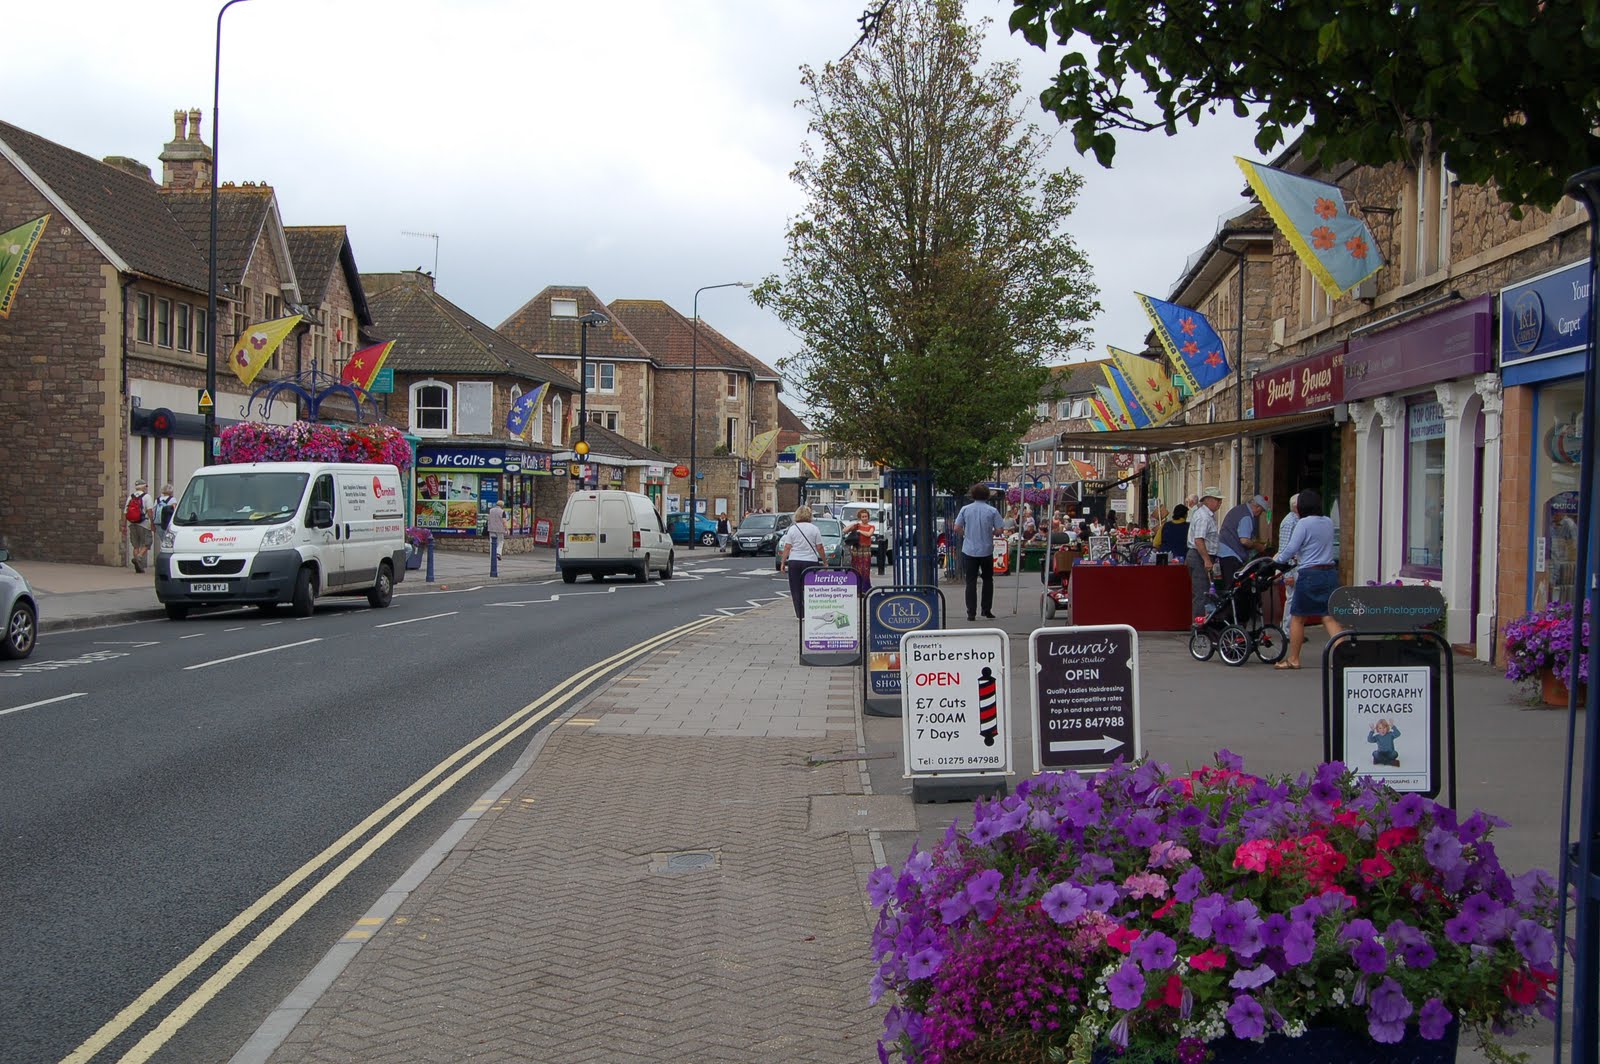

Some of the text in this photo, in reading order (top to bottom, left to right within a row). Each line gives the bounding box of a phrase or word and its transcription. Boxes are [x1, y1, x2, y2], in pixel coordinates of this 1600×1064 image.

[1572, 280, 1590, 301] Your
[1558, 317, 1581, 337] Carpet
[1266, 366, 1332, 408] Juicy Jones
[1412, 406, 1424, 425] TOP
[814, 574, 848, 584] heritage
[888, 602, 920, 617] T&L
[1333, 606, 1441, 616] Perception Photography
[1048, 638, 1118, 656] Laura's
[914, 649, 996, 662] Barbershop
[1080, 656, 1106, 664] Studio
[916, 672, 960, 686] OPEN
[1065, 668, 1100, 681] OPEN
[1362, 673, 1408, 684] PORTRAIT
[1347, 688, 1424, 699] PHOTOGRAPHY
[916, 698, 966, 710] £7 Cuts
[1358, 703, 1414, 714] PACKAGES
[916, 712, 966, 724] 7:00AM
[1048, 716, 1125, 730] 01275 847988
[916, 728, 960, 742] 7 Days
[938, 757, 964, 765] 01275
